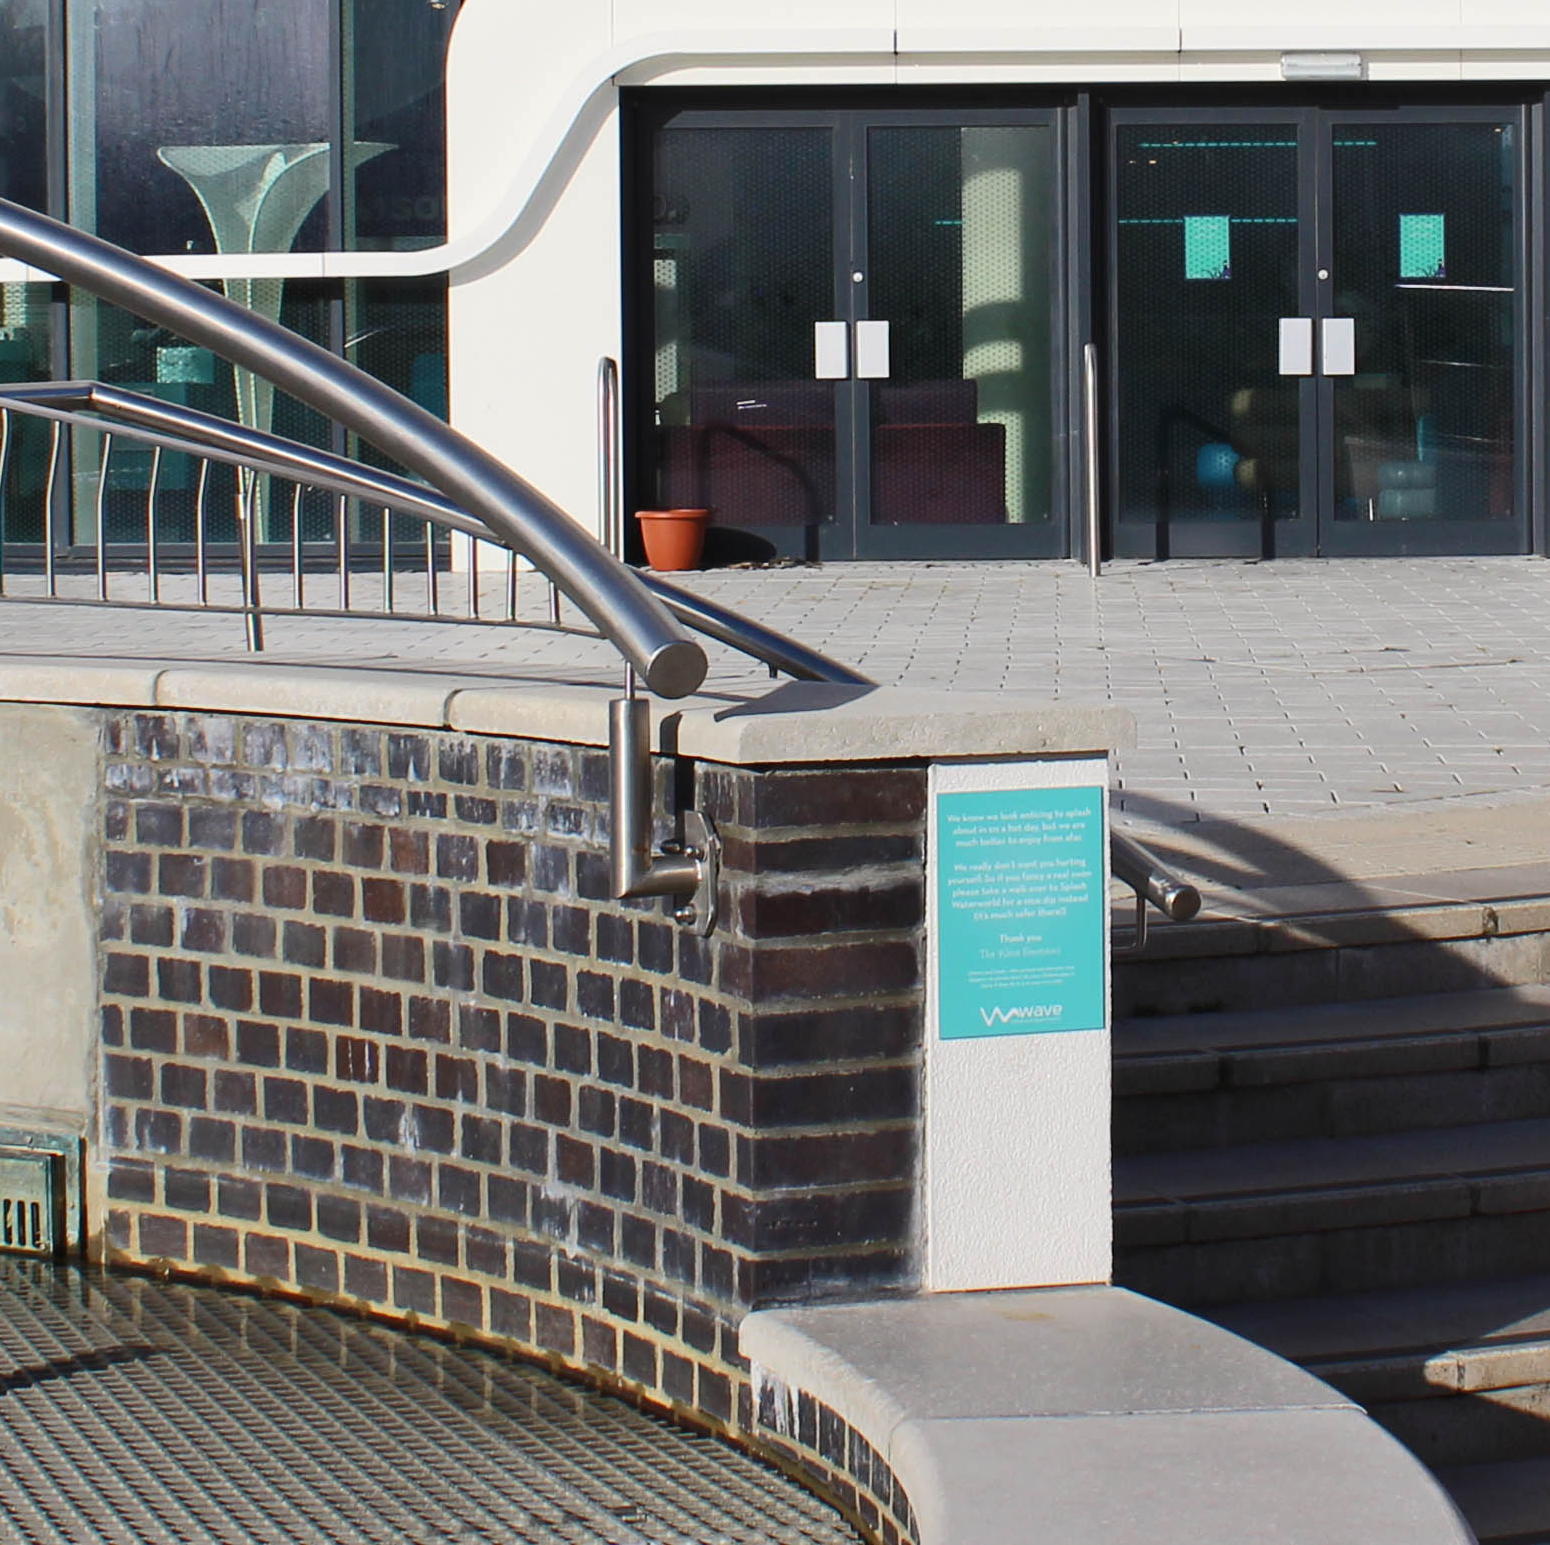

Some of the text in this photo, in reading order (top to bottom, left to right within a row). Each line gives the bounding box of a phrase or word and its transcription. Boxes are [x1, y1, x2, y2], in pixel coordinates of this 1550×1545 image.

[947, 814, 961, 823] We
[962, 813, 985, 822] know
[1000, 811, 1018, 821] look
[1019, 810, 1053, 820] enticing
[1054, 810, 1065, 818] to
[1065, 807, 1092, 819] splash
[953, 825, 977, 835] about
[1007, 822, 1023, 832] hot
[1042, 821, 1057, 831] but
[1071, 821, 1086, 829] are
[955, 837, 978, 847] much
[980, 836, 1006, 846] better
[1007, 835, 1017, 844] to
[1017, 834, 1042, 846] enjoy
[1043, 831, 1064, 842] from
[953, 858, 1086, 872] We really don't want you hurting
[1005, 874, 1021, 884] you
[1021, 871, 1045, 883] fancy
[1053, 869, 1070, 880] real
[952, 887, 980, 899] please
[981, 886, 999, 896] take
[1008, 884, 1027, 894] walk
[1028, 885, 1047, 893] over
[1049, 883, 1059, 892] to
[951, 897, 1001, 909] Waterworld
[1002, 896, 1014, 906] for
[990, 909, 1013, 920] much
[1014, 908, 1036, 919] safer
[999, 932, 1043, 945] Thank you
[1017, 1003, 1064, 1018] wave
